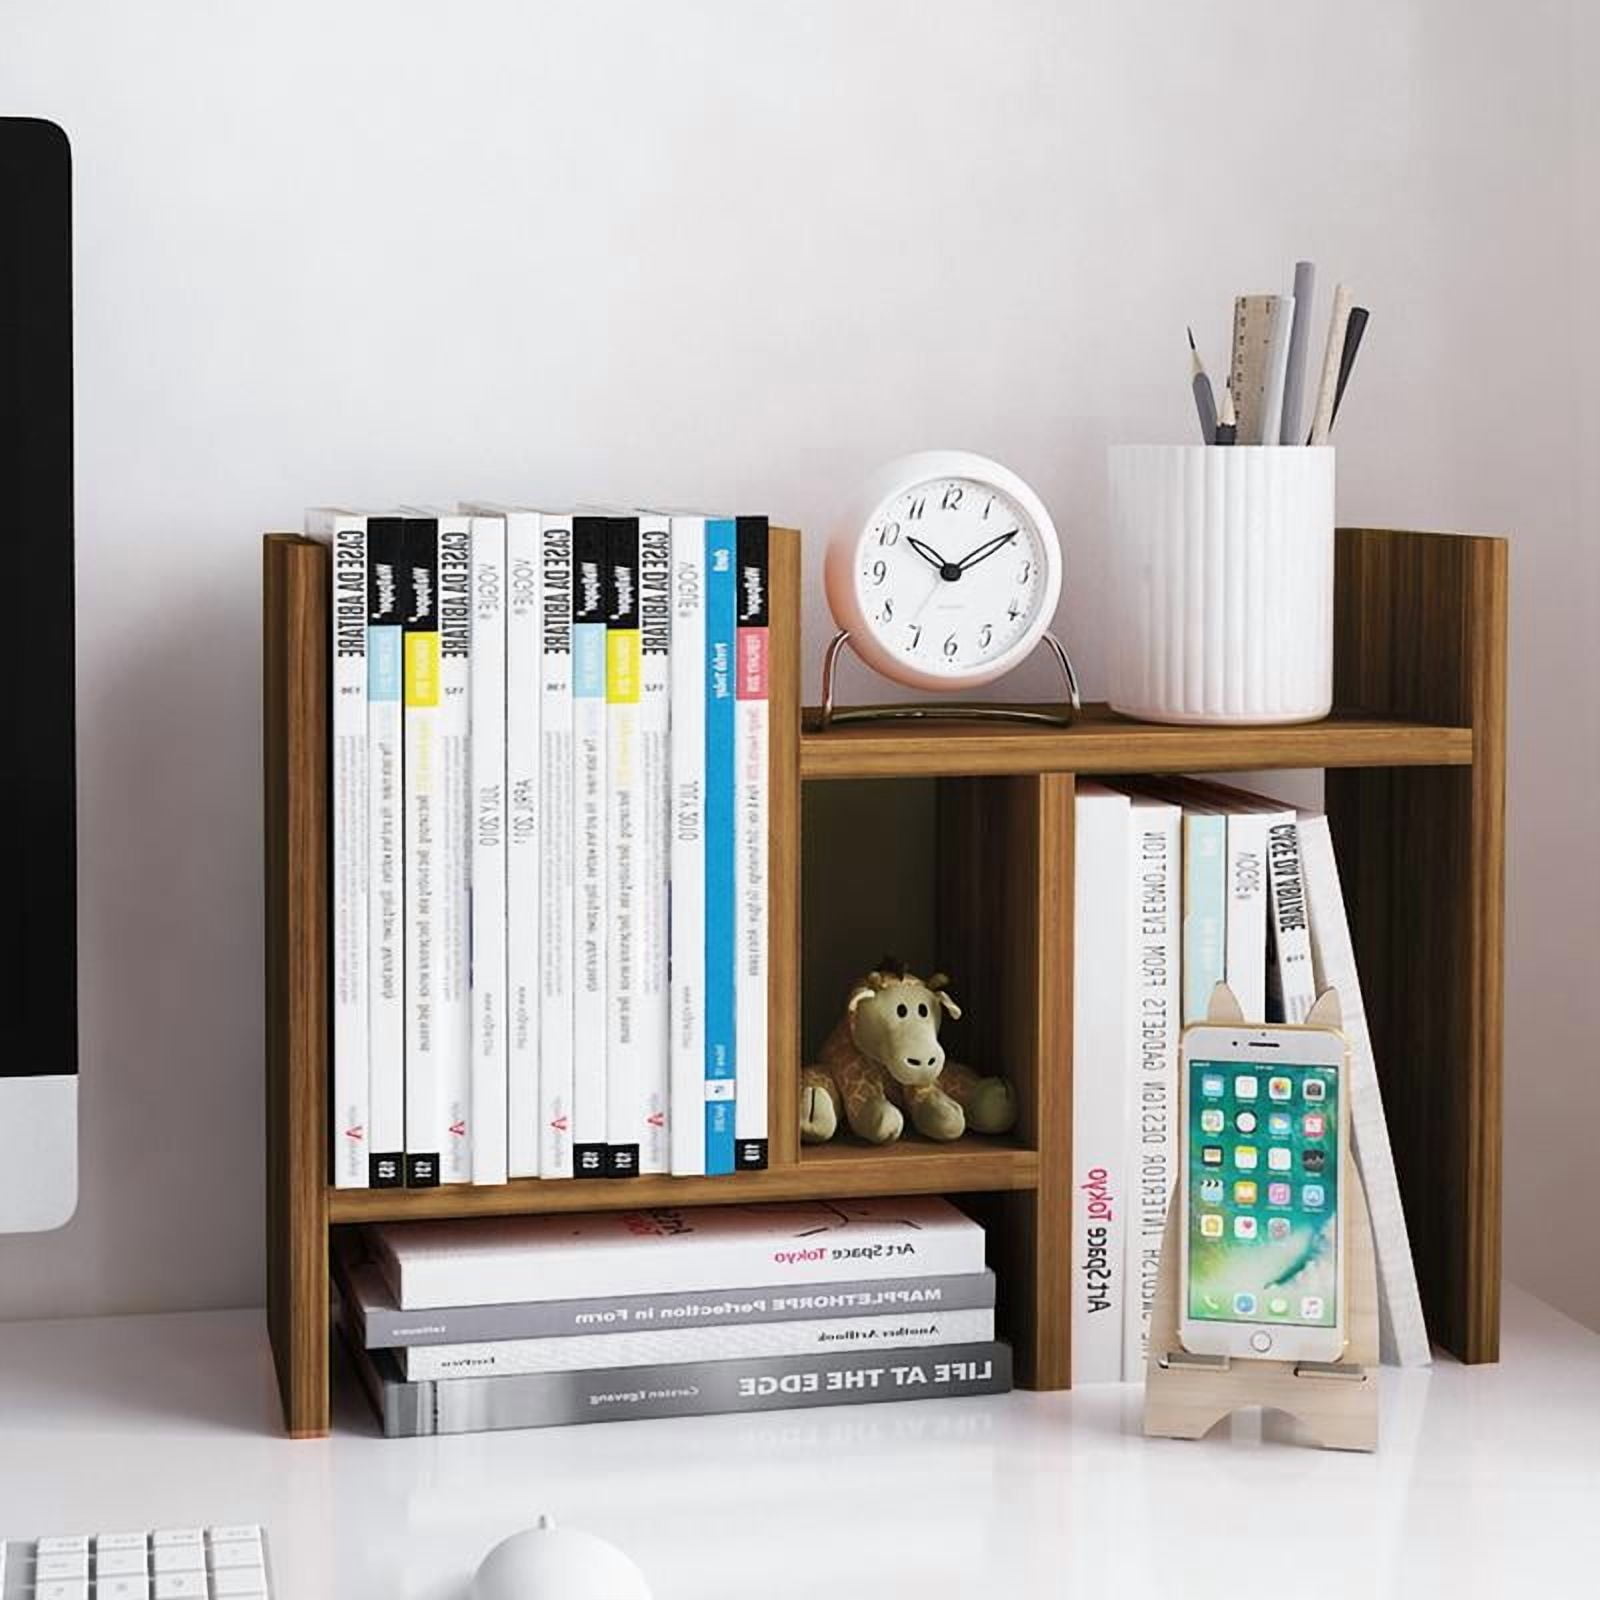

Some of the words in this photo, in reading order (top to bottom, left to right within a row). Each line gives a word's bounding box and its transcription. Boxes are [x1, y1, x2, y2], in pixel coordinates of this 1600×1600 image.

[908, 498, 926, 520] 11
[942, 487, 963, 511] 12
[983, 498, 992, 520] 1
[879, 522, 901, 546] 10
[873, 560, 887, 586] 9
[1019, 560, 1031, 584] 3
[882, 598, 893, 623] 8
[1007, 599, 1022, 621] 4
[908, 624, 922, 649] 7
[944, 632, 958, 656] 6
[979, 623, 993, 648] 5
